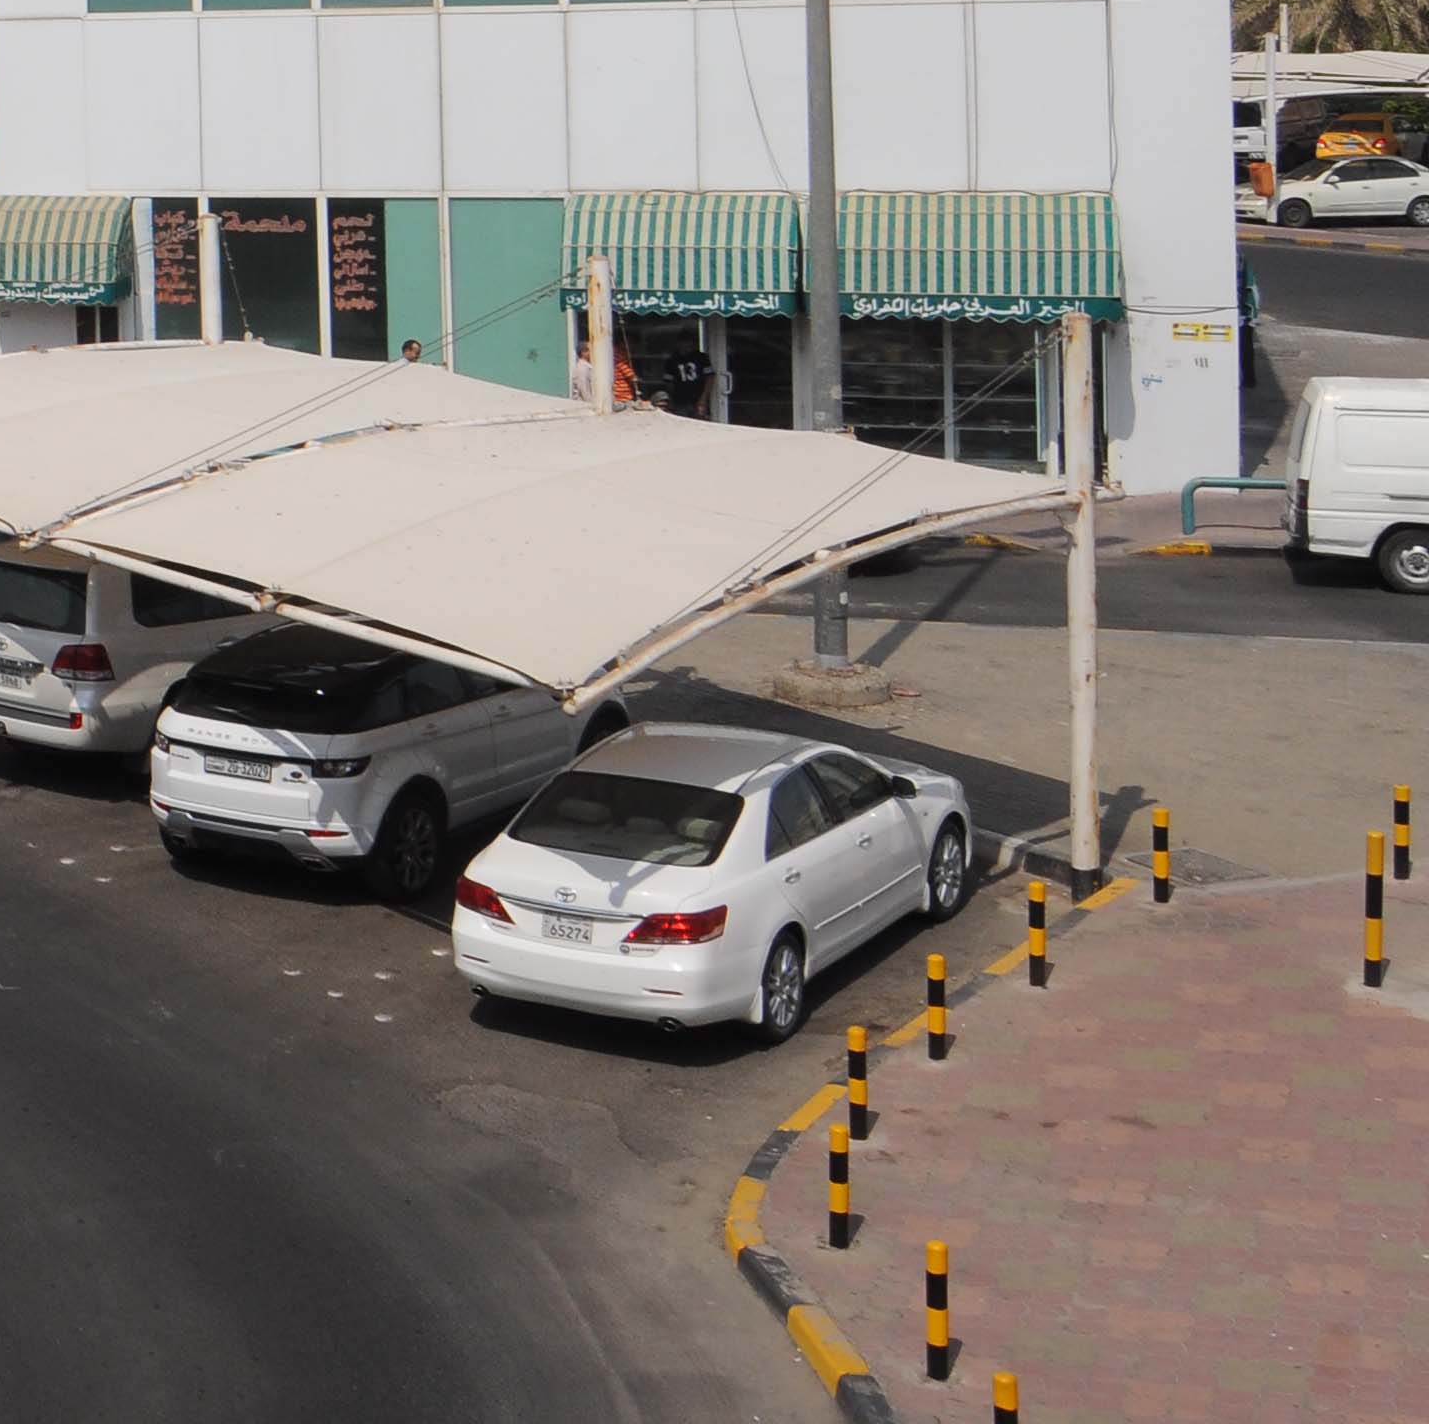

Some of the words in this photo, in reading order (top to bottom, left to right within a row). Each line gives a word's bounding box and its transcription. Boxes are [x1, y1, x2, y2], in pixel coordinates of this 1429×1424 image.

[964, 296, 1030, 317] العربي
[677, 361, 698, 382] 13
[549, 924, 590, 941] 65274
